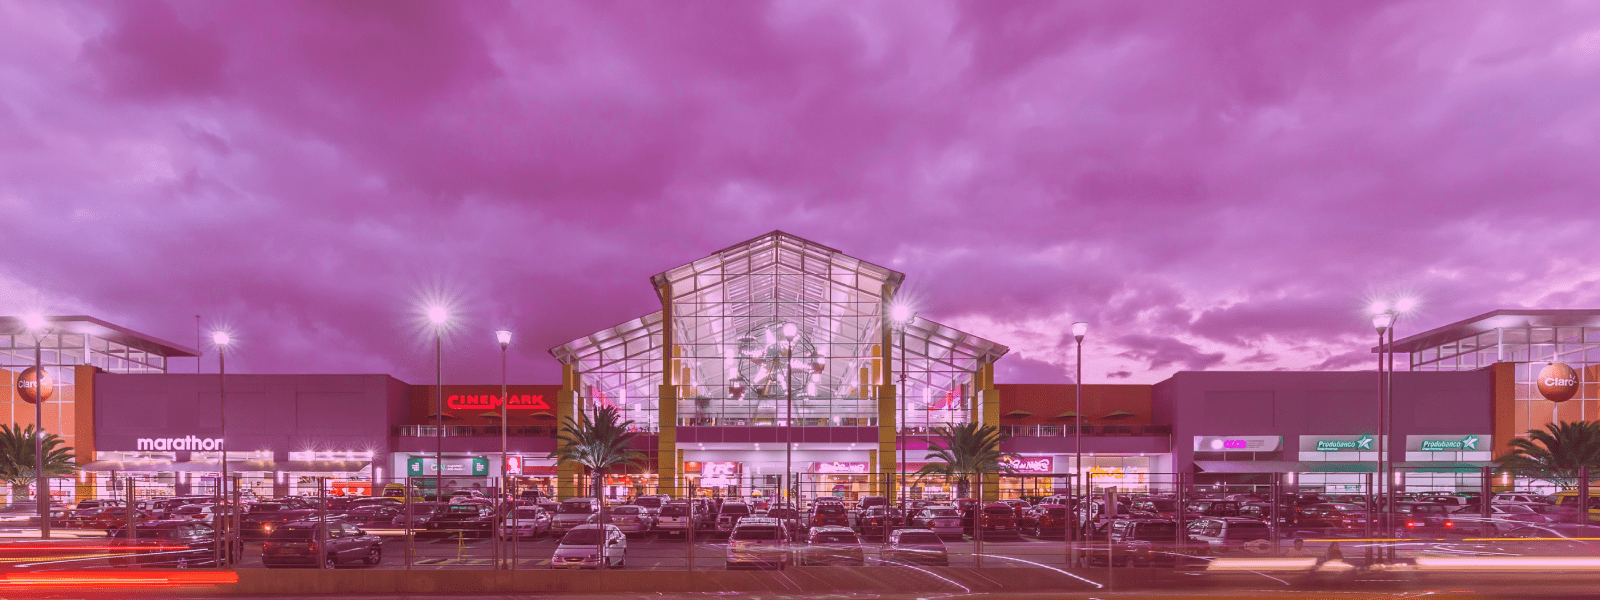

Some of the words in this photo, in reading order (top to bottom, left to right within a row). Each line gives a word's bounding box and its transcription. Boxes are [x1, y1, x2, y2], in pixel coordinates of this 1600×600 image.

[1544, 377, 1574, 387] Claro
[447, 391, 550, 409] CINEMARK
[137, 435, 224, 451] marathon
[1317, 440, 1356, 448] Produbanco
[1422, 440, 1461, 448] Produbanco
